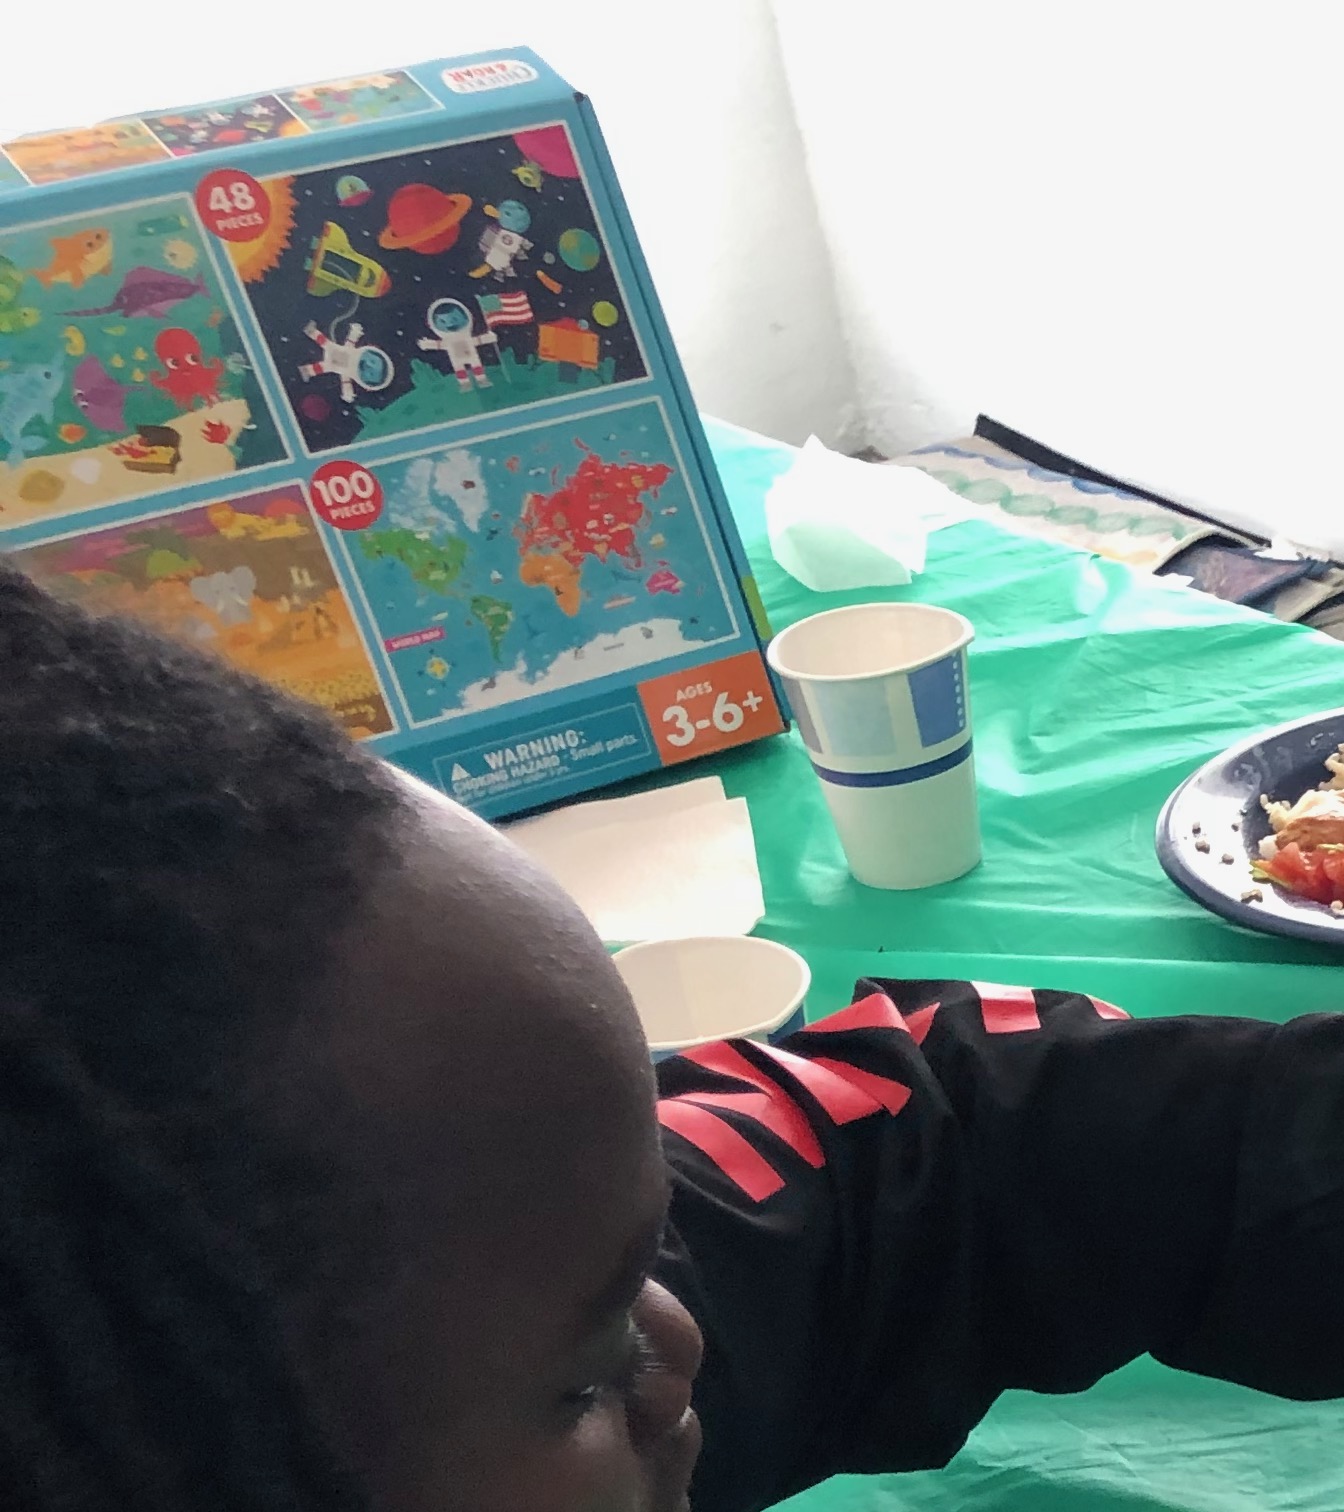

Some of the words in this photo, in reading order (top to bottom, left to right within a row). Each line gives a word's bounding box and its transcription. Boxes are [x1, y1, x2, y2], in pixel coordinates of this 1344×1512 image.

[209, 182, 256, 213] 48
[215, 212, 264, 231] PIECES
[313, 470, 375, 506] 100
[329, 500, 376, 519] PIECES
[676, 681, 712, 702] AGES
[662, 690, 763, 747] 3-6+
[483, 729, 587, 770] WARNING:
[510, 754, 560, 778] HAZARD
[570, 740, 605, 761] Small
